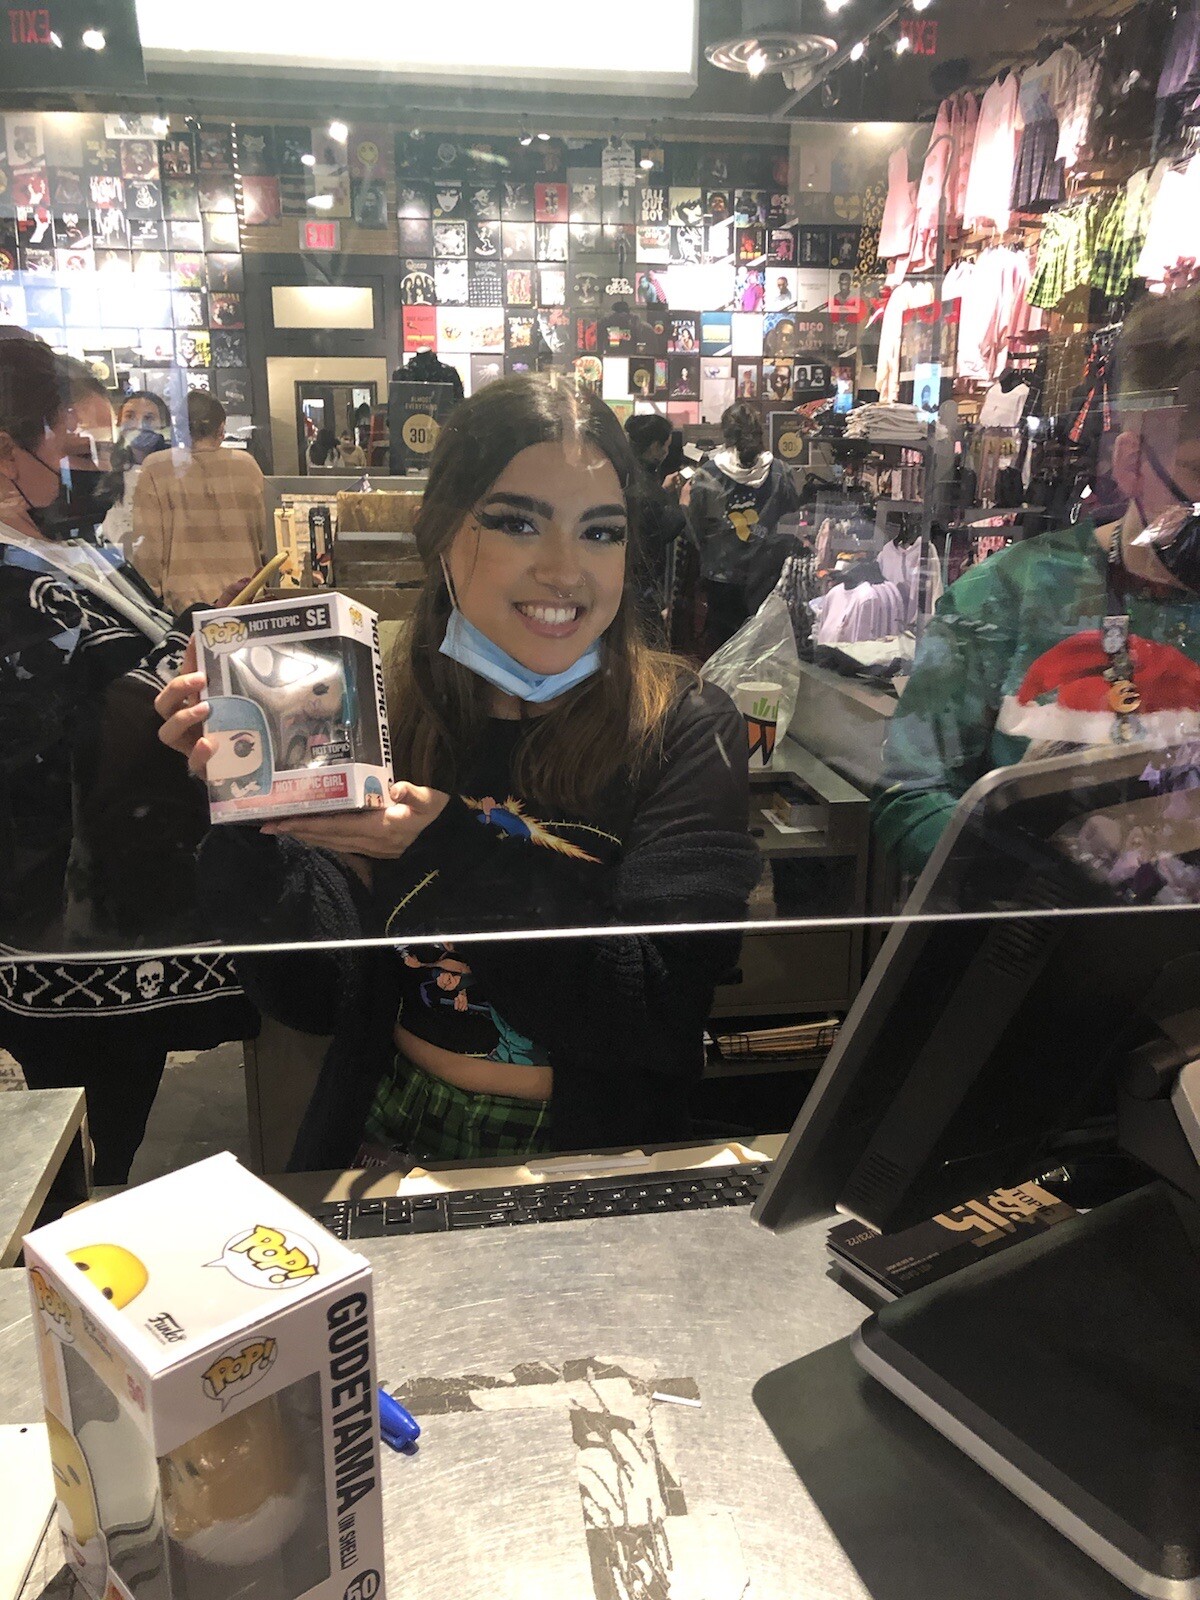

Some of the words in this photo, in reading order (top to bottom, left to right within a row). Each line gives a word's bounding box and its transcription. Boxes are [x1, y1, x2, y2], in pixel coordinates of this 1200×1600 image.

[641, 188, 664, 201] FALL
[642, 200, 664, 211] OUT
[641, 210, 664, 222] BOY
[799, 321, 825, 332] RICO
[248, 618, 269, 633] HOT
[271, 615, 301, 631] TOPIC
[305, 608, 327, 627] SE
[312, 745, 327, 756] HOT
[323, 775, 344, 788] GIRL
[148, 1311, 187, 1344] Funko
[326, 1291, 376, 1517] GUDETAMA
